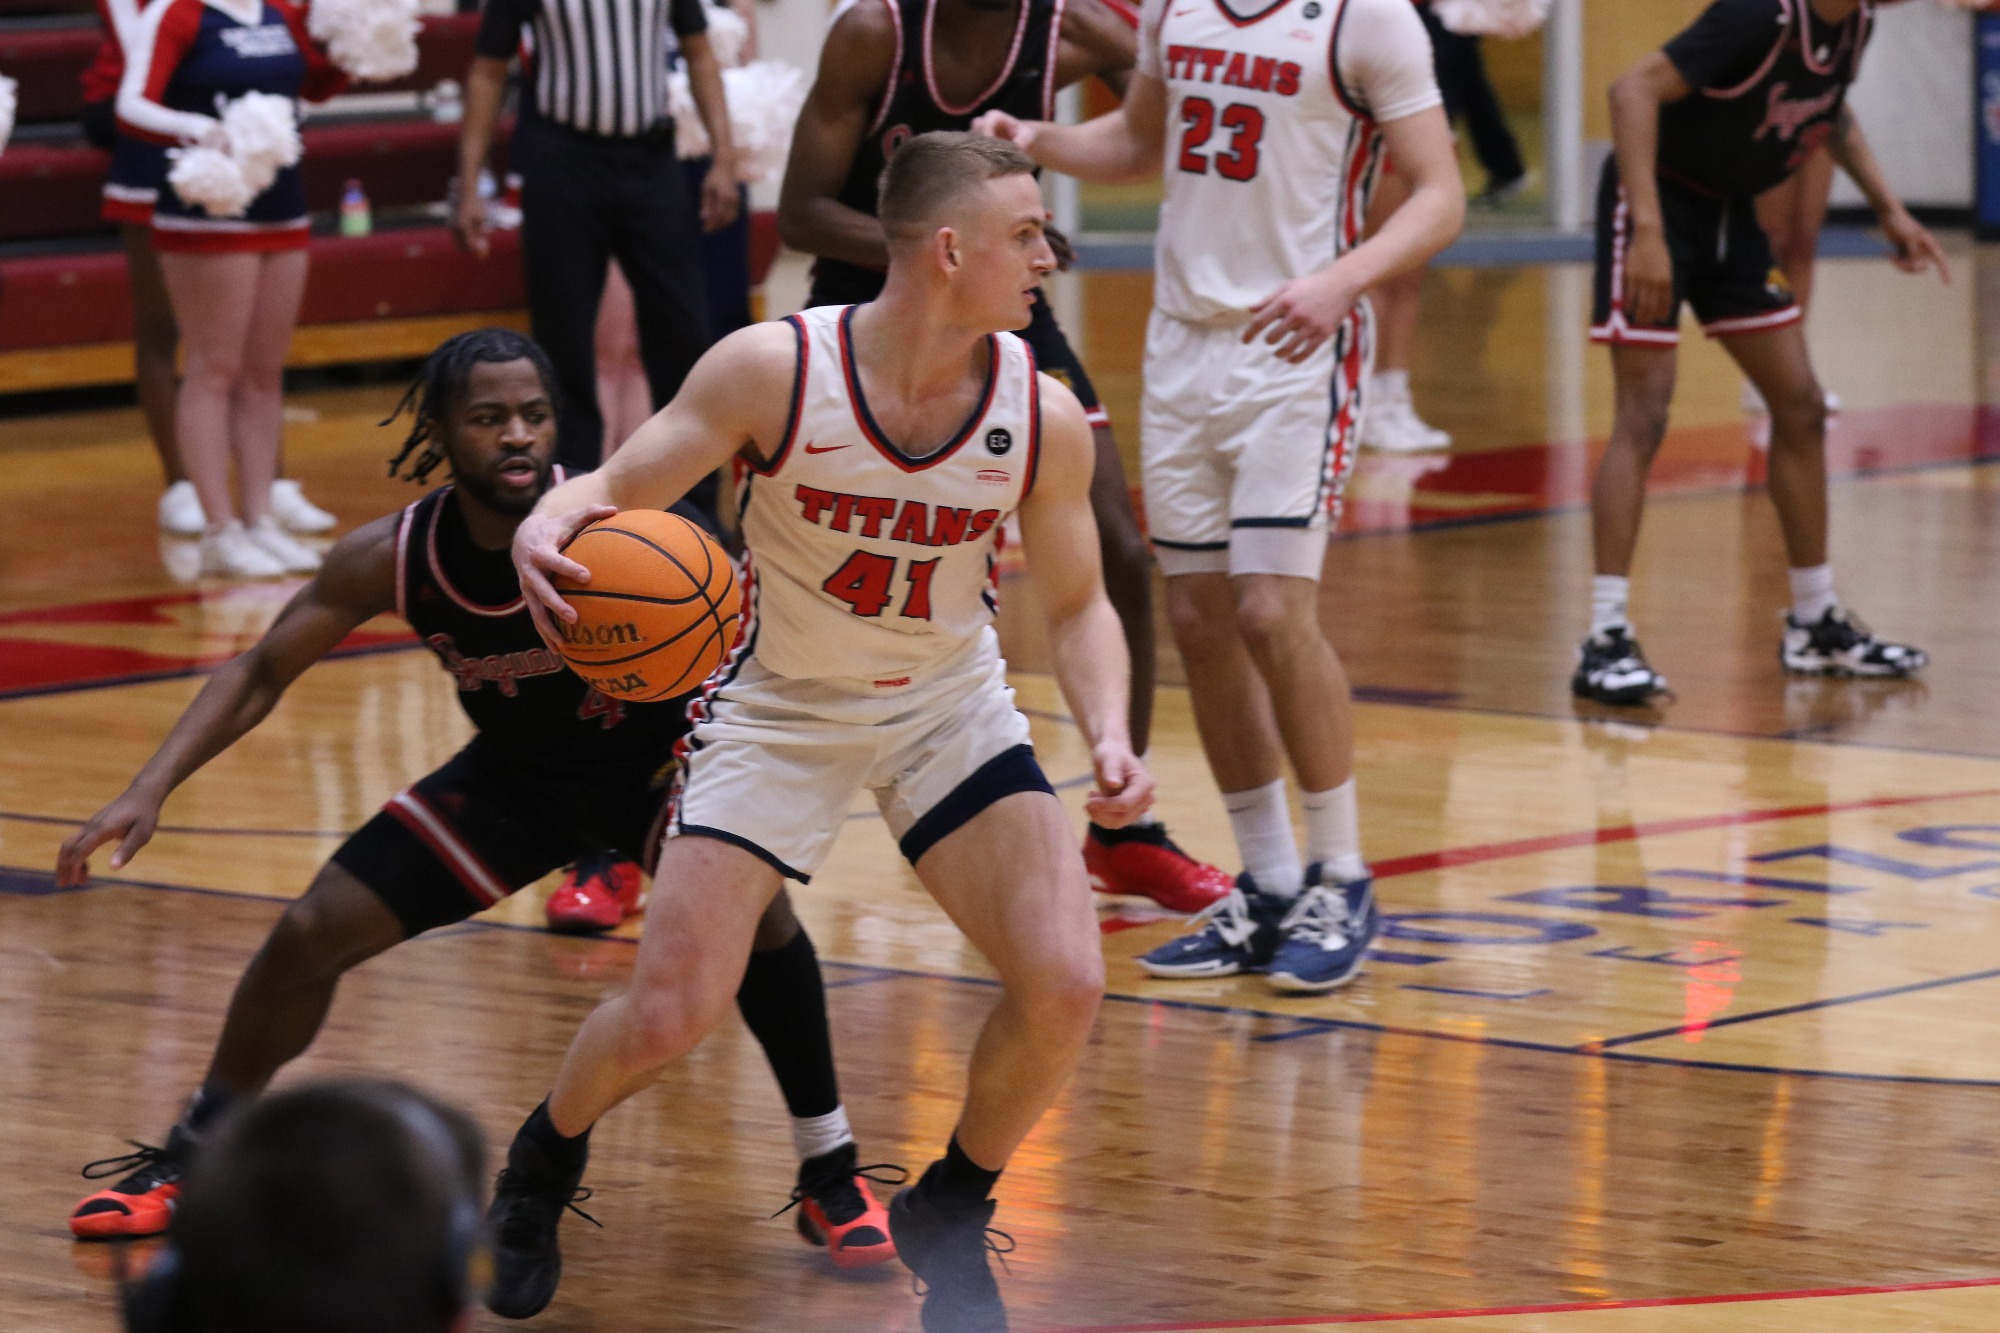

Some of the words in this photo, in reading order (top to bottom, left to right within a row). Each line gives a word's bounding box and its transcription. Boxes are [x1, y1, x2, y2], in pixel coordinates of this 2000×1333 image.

[1167, 44, 1303, 97] TITANS
[1178, 95, 1266, 183] 23
[794, 483, 1002, 547] TITANS
[821, 548, 944, 622] 41
